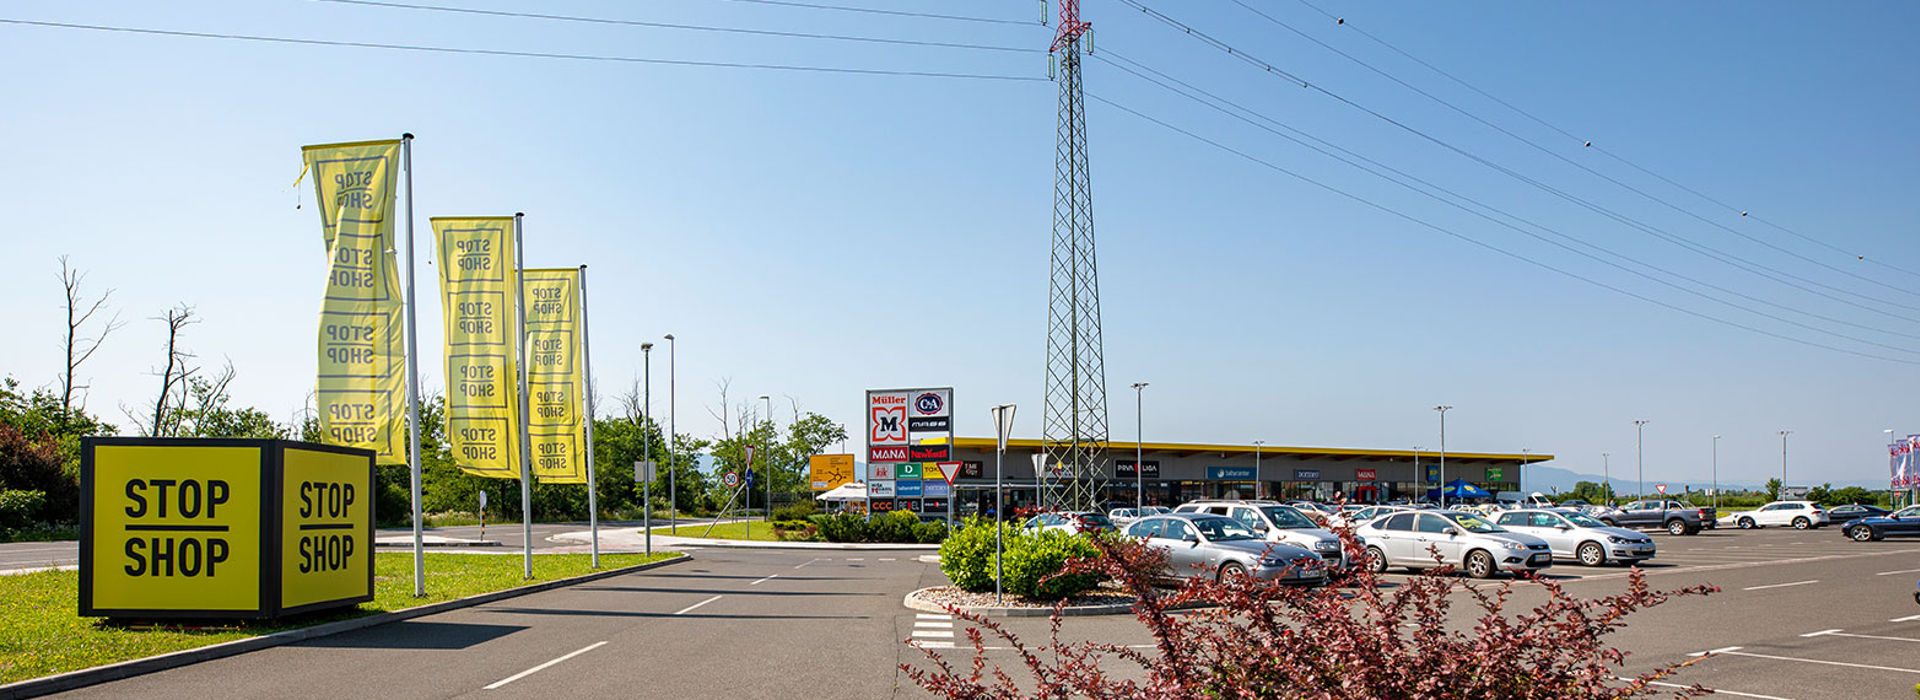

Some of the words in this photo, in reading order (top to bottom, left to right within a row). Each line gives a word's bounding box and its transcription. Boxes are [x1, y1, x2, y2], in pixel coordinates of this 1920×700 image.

[872, 396, 906, 405] Müller
[880, 417, 898, 432] M
[873, 449, 906, 459] MANA
[905, 465, 913, 474] D
[727, 475, 736, 484] 50
[125, 478, 230, 519] STOP
[299, 481, 355, 519] STOP
[872, 501, 892, 510] CCC
[124, 537, 230, 577] SHOP
[299, 534, 355, 574] SHOP
